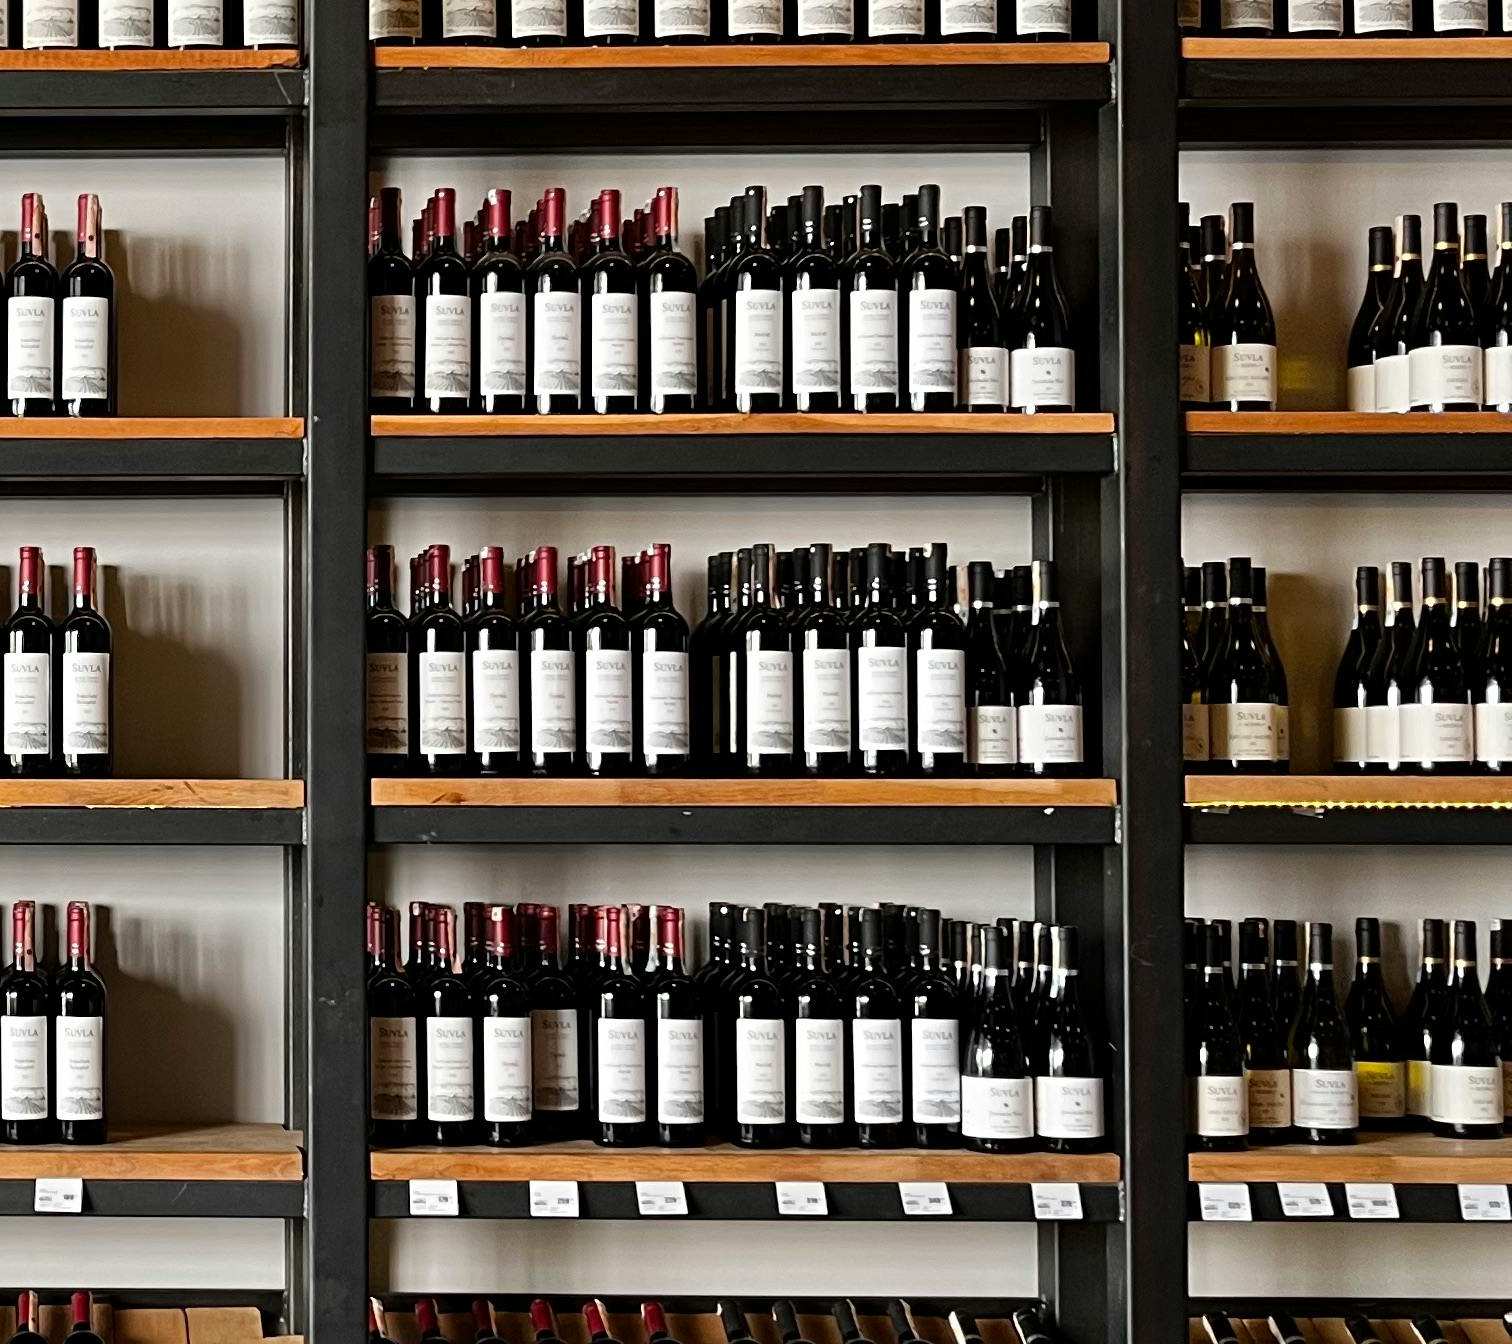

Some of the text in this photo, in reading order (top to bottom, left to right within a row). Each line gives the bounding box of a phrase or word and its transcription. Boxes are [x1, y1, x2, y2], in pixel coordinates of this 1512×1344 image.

[435, 305, 465, 316] SUVLA
[544, 302, 575, 313] SUVLA
[662, 302, 692, 313] SUVLA
[861, 299, 893, 313] SUVLA
[919, 300, 952, 311] SUVLA
[70, 308, 100, 318] SUVLA
[966, 354, 998, 368] SUVLA
[1232, 352, 1264, 363] SUVLA
[1441, 352, 1473, 366] SUVLA
[72, 663, 102, 673] SUVLA
[481, 660, 513, 671] SUVLA
[653, 662, 685, 673] SUVLA
[758, 661, 789, 673] SUVLA
[1044, 713, 1074, 724] SUVLA
[1235, 711, 1267, 721] SUVLA
[1434, 710, 1466, 724] SUVLA
[64, 1027, 95, 1039] SUVLA
[435, 1027, 467, 1040] SUVLA
[607, 1029, 640, 1041] SUVLA
[668, 1030, 700, 1041] SUVLA
[1314, 1078, 1347, 1089] SUVLA
[1467, 1075, 1500, 1086] SUVLA
[1207, 1085, 1239, 1097] SUVLA
